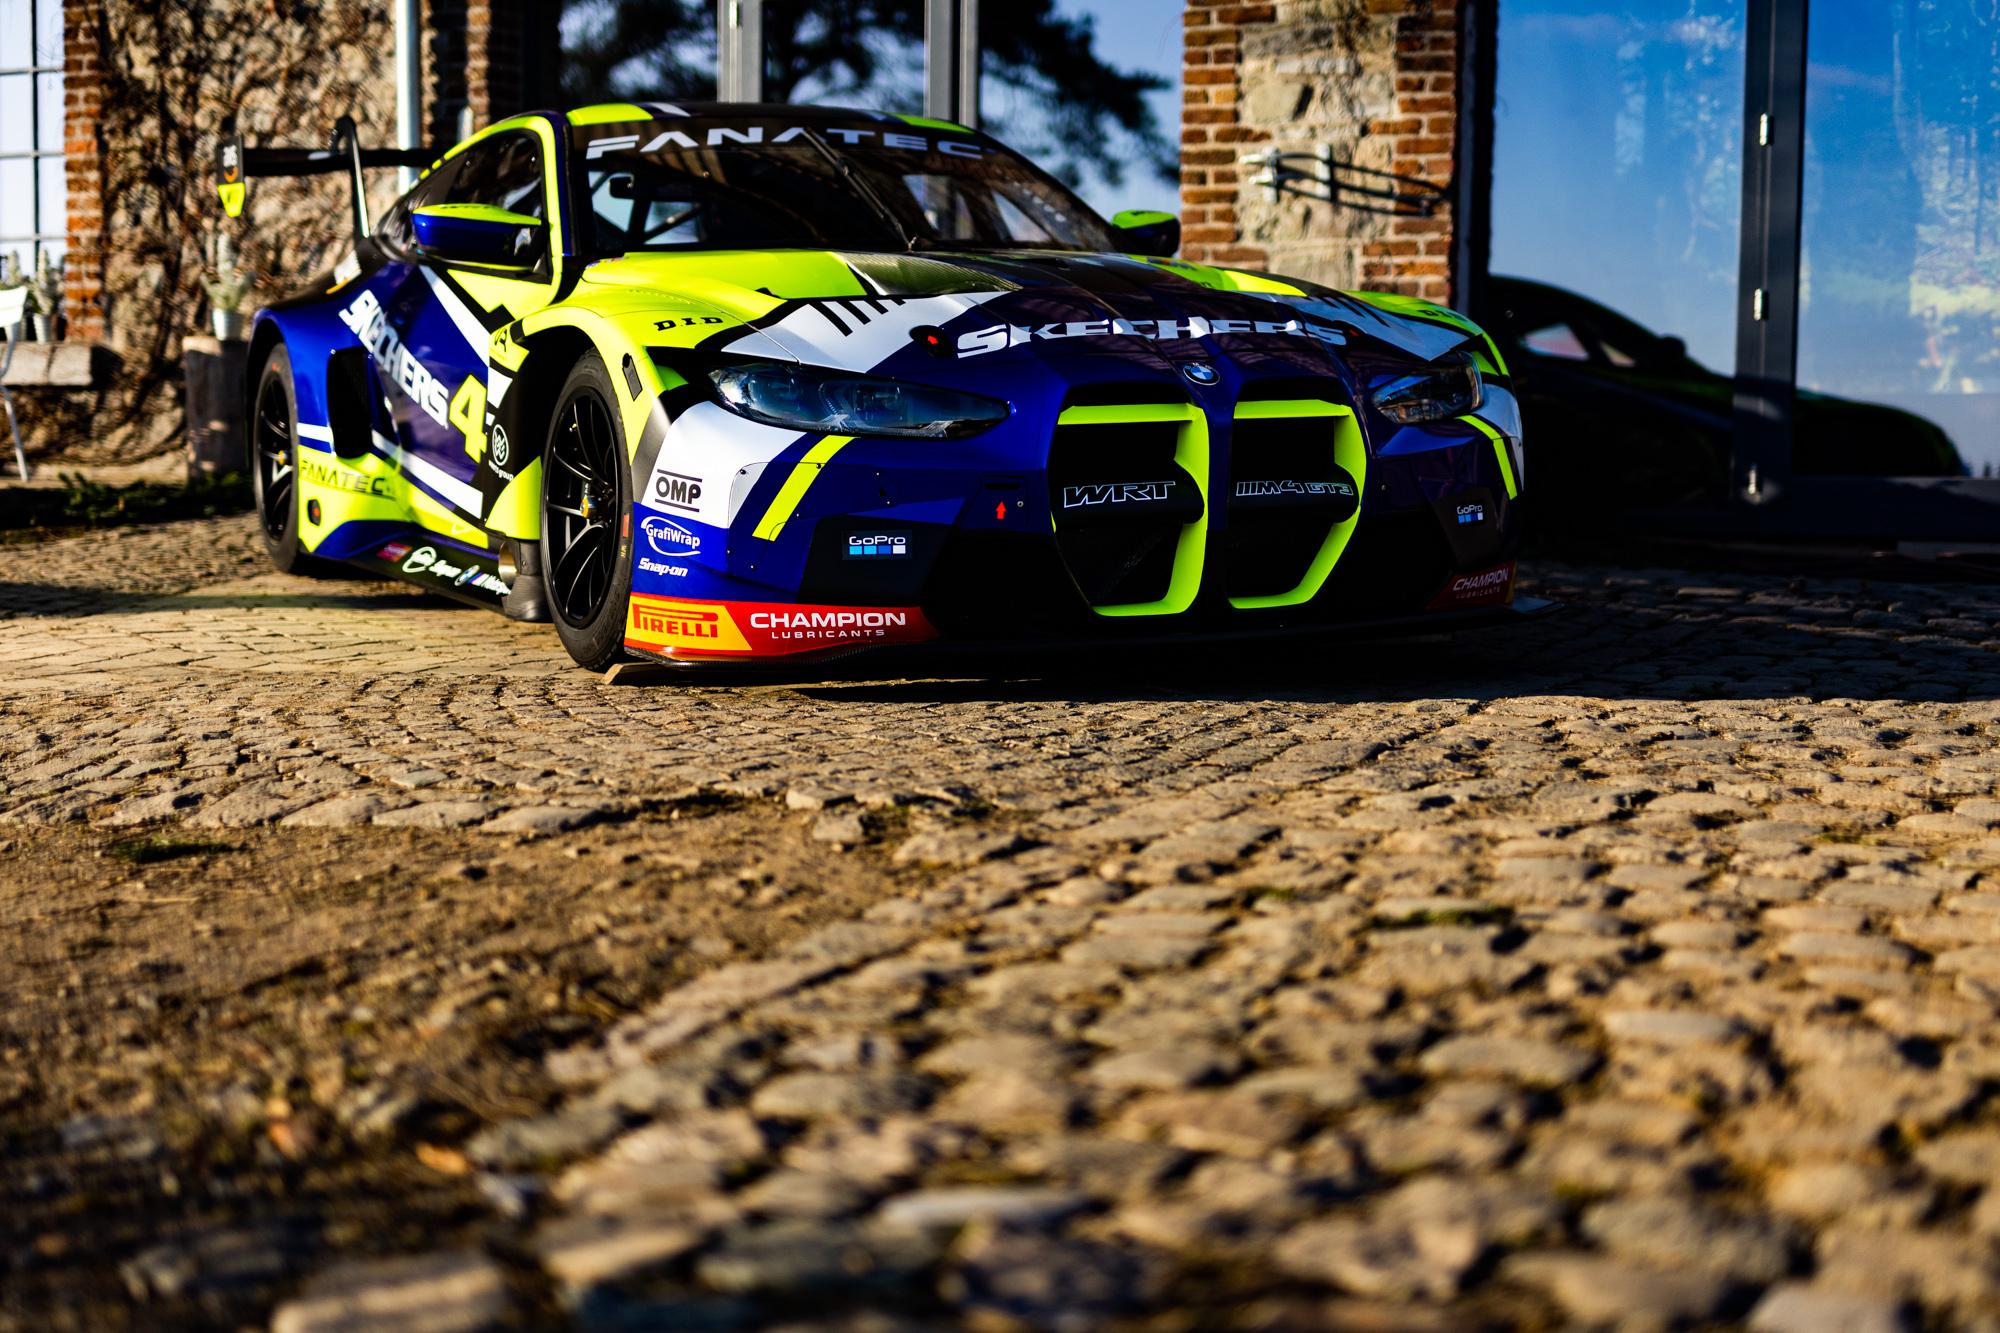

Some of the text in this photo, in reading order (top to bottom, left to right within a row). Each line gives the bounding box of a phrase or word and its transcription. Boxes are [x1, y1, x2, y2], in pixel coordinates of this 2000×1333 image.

[586, 126, 983, 159] FANATEC
[653, 316, 724, 331] D.I.D
[957, 316, 1347, 359] SKECHERS
[338, 289, 488, 464] SKECHERS 4
[300, 459, 387, 494] FANATEC
[656, 476, 702, 505] OMP
[1063, 481, 1176, 508] WRT
[1456, 504, 1484, 515] GoPro
[646, 523, 701, 550] GrafiWrap
[849, 535, 906, 546] GoPro
[638, 557, 689, 577] Snap-on
[1453, 568, 1509, 591] CHAMPION
[1456, 585, 1501, 599] LUBRICANTS
[632, 602, 719, 638] PIRELLI
[750, 612, 906, 629] CHAMPION
[771, 629, 885, 640] LUBRICANTS
